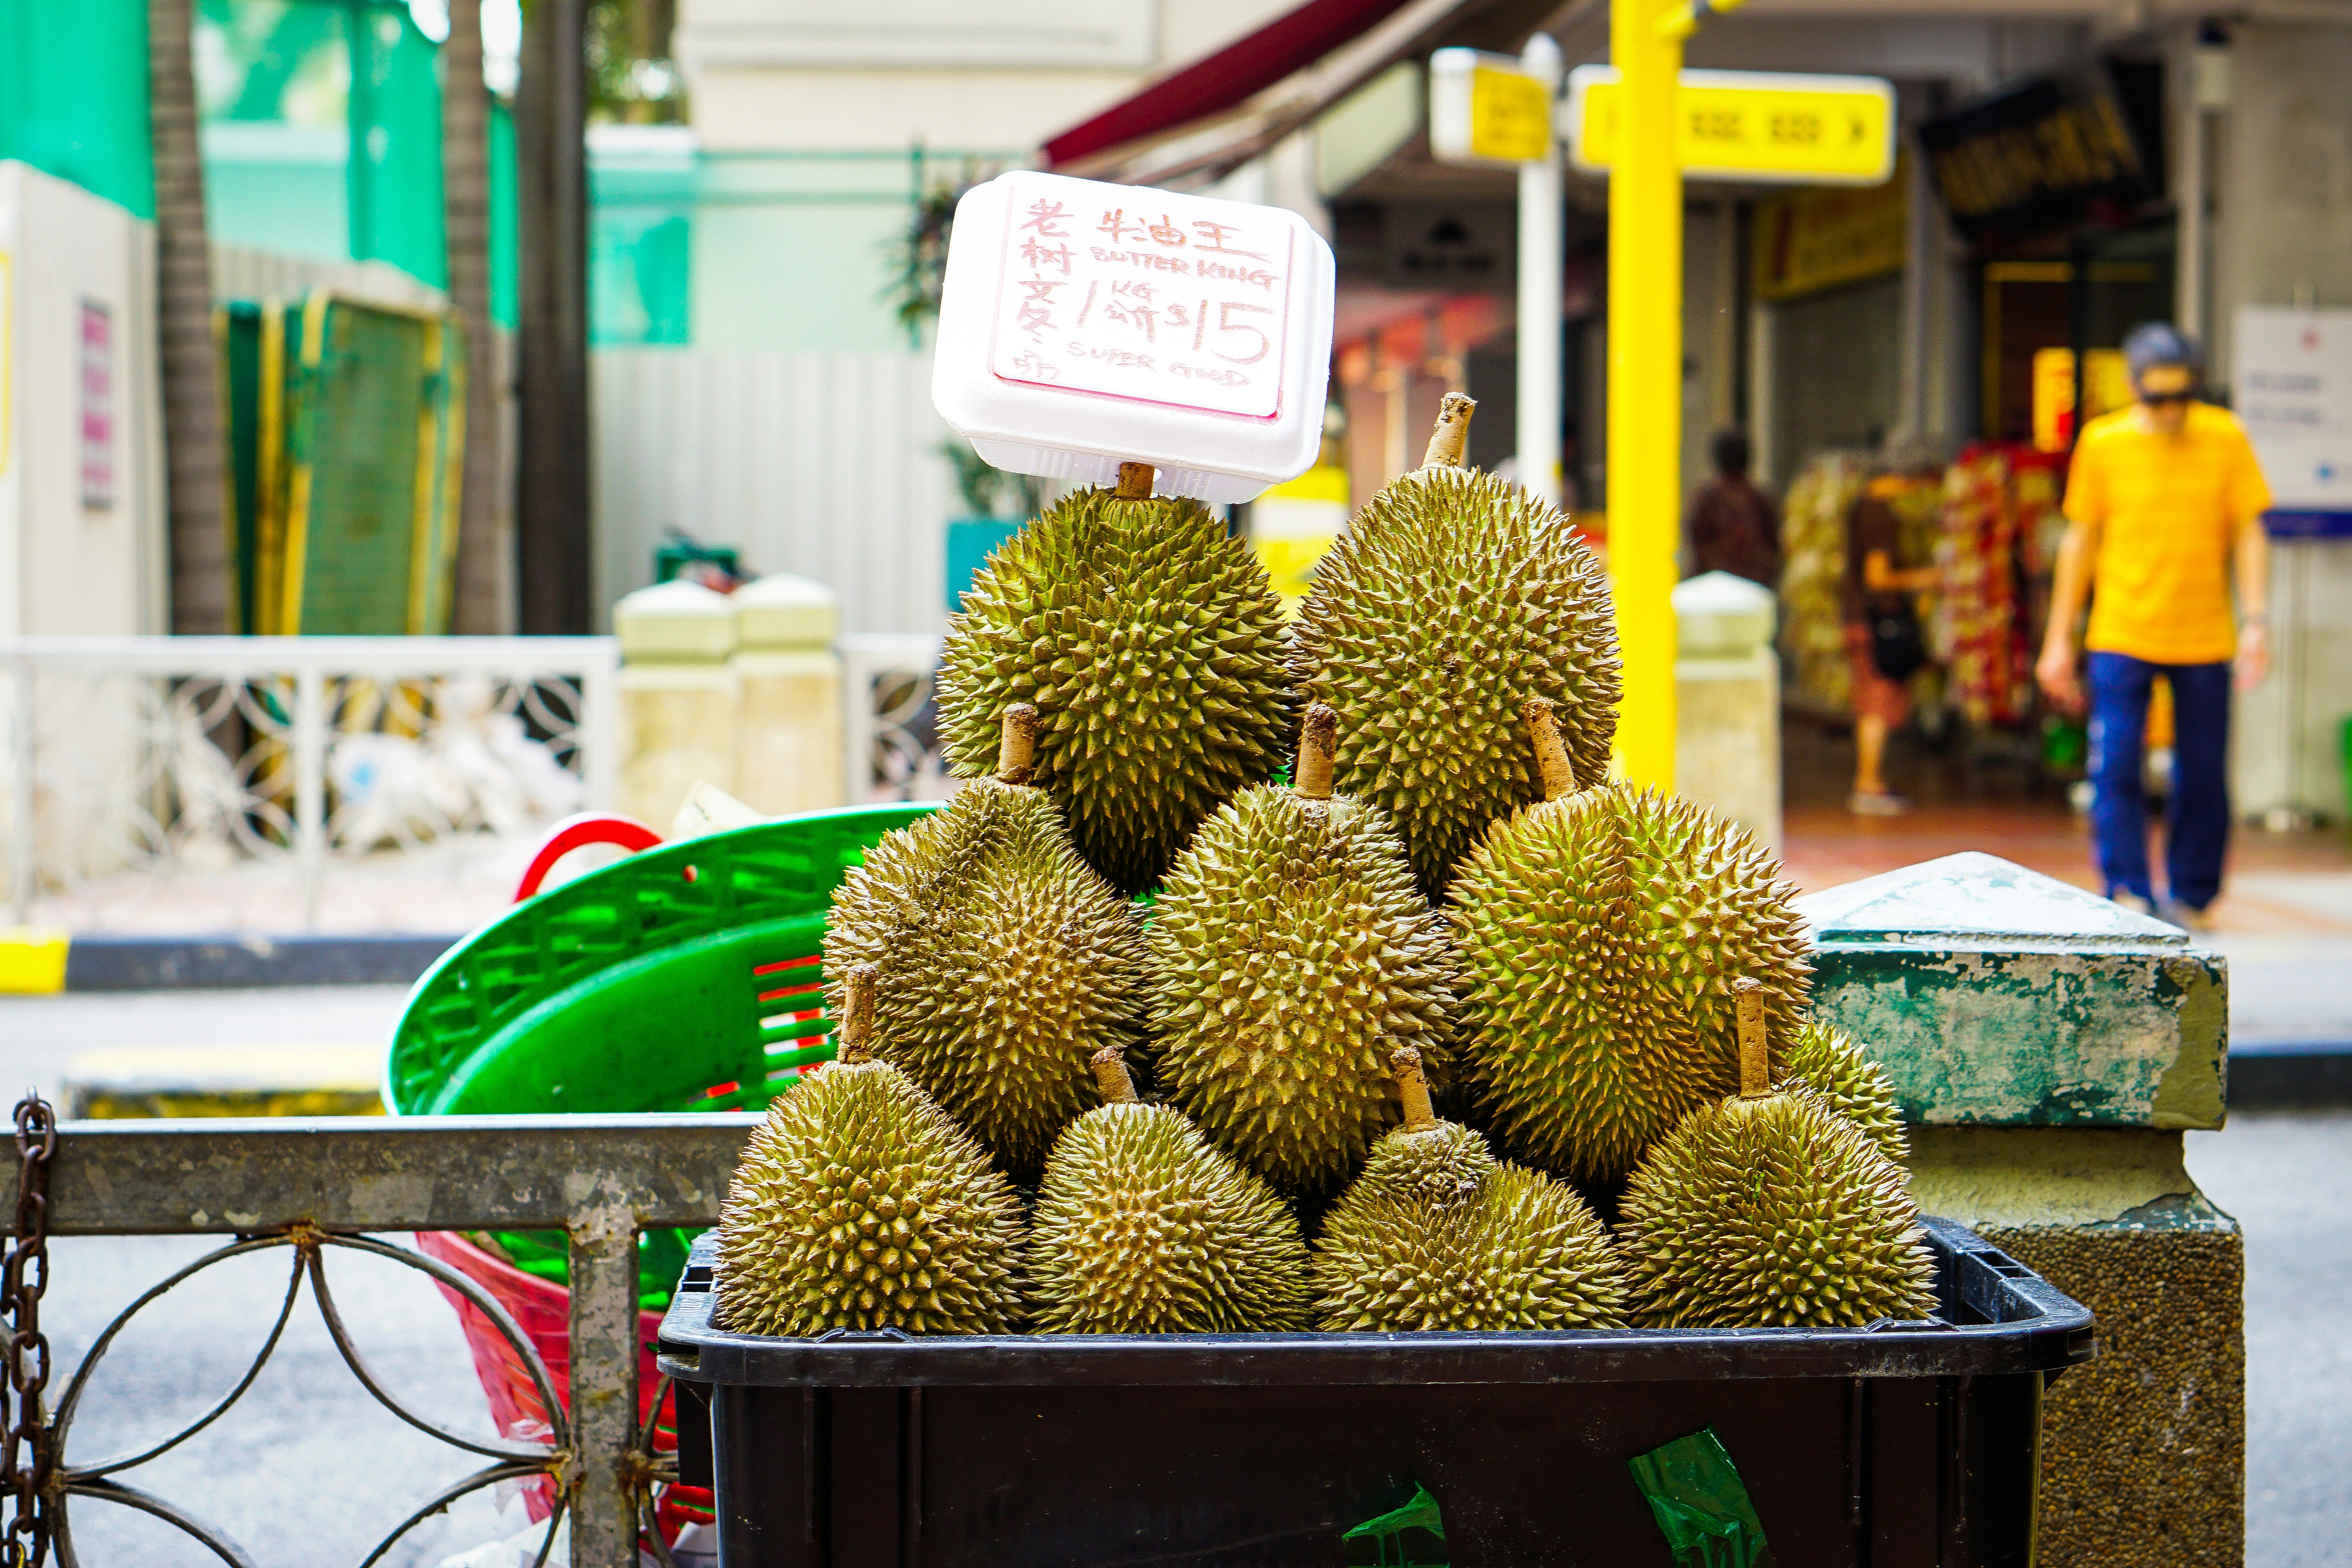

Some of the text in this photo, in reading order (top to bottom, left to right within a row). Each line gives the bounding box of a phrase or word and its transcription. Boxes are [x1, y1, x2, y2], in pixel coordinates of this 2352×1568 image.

[1096, 208, 1272, 264] 牛油王
[1090, 247, 1281, 292] BUTTER KING
[1111, 280, 1159, 304] KG
[1067, 342, 1251, 387] SUPER GOOD
